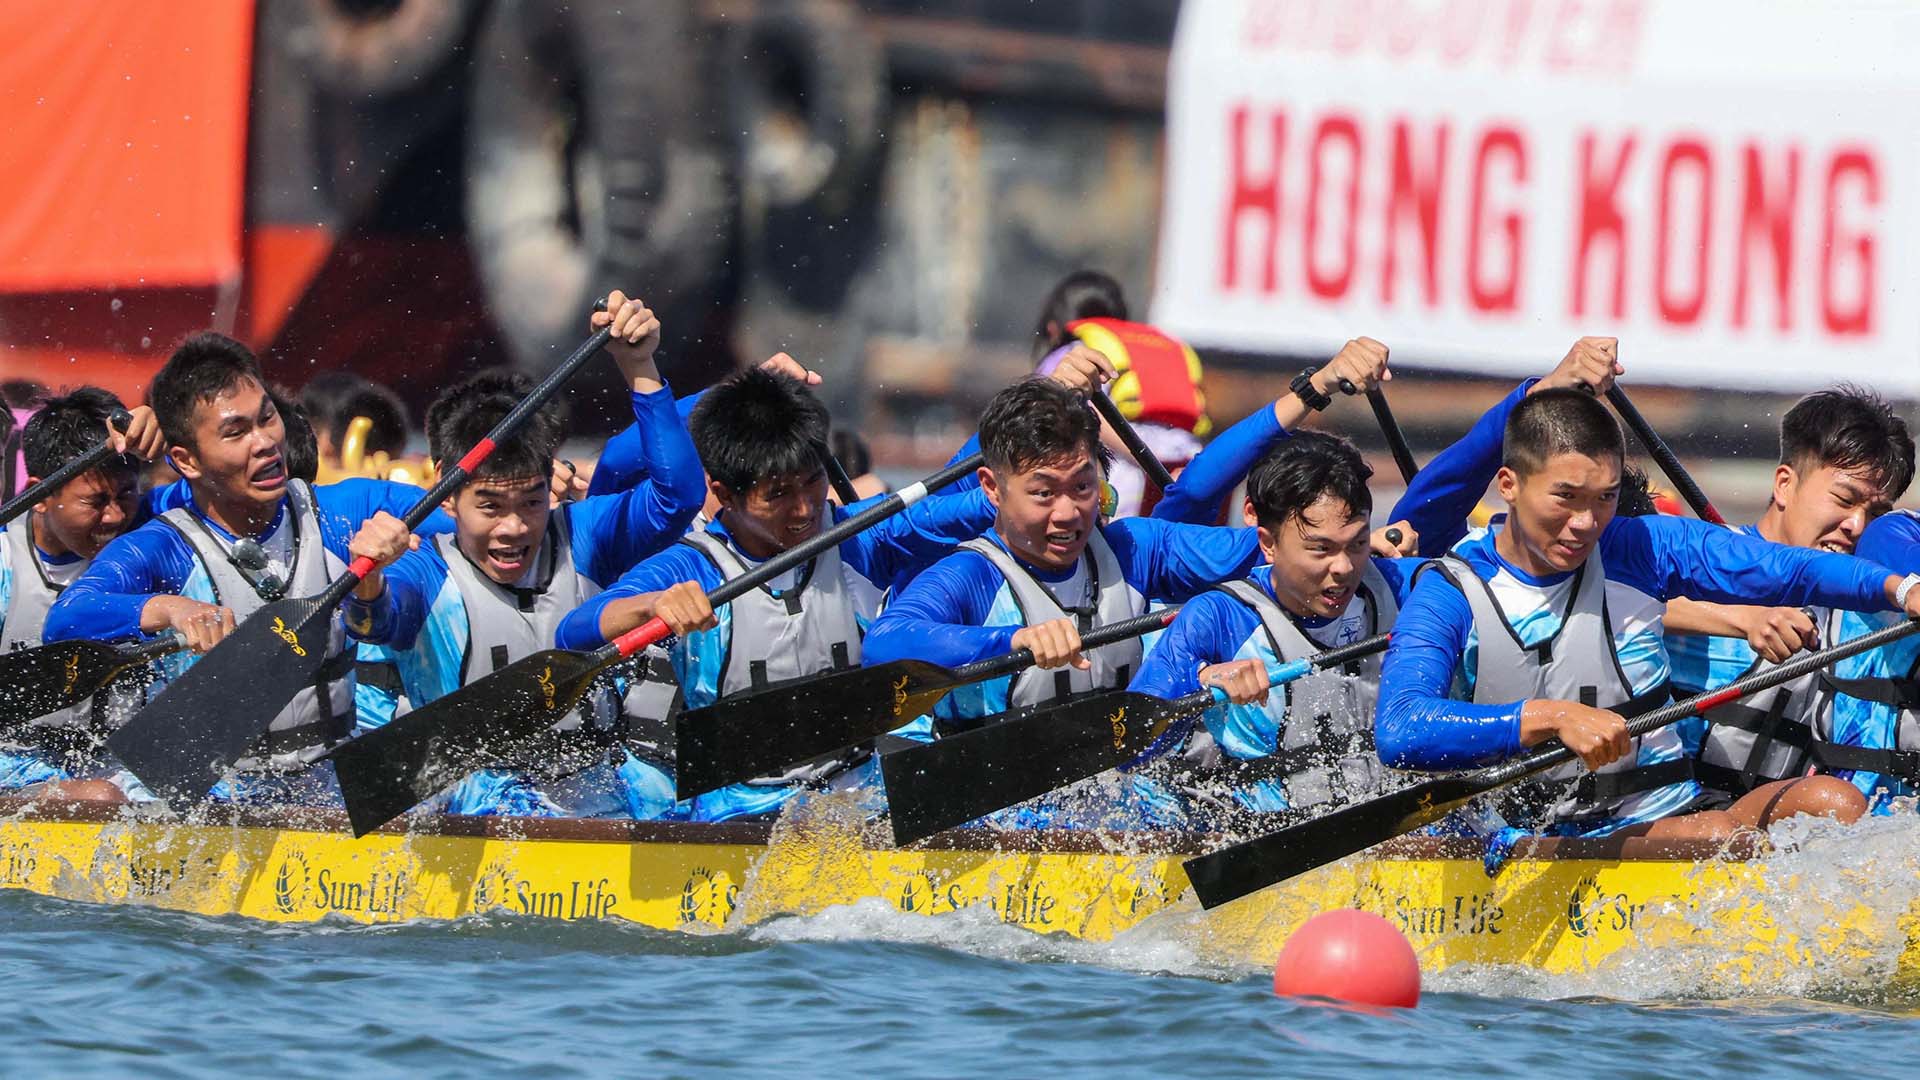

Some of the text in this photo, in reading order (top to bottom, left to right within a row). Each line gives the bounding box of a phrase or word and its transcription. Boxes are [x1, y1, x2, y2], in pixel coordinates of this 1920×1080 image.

[1219, 106, 1880, 337] HONG KONG
[0, 842, 36, 884] ife
[315, 869, 406, 913] Sun Lif
[515, 878, 617, 920] Sun Life
[1004, 881, 1055, 924] Life
[1396, 892, 1504, 934] Sun Life
